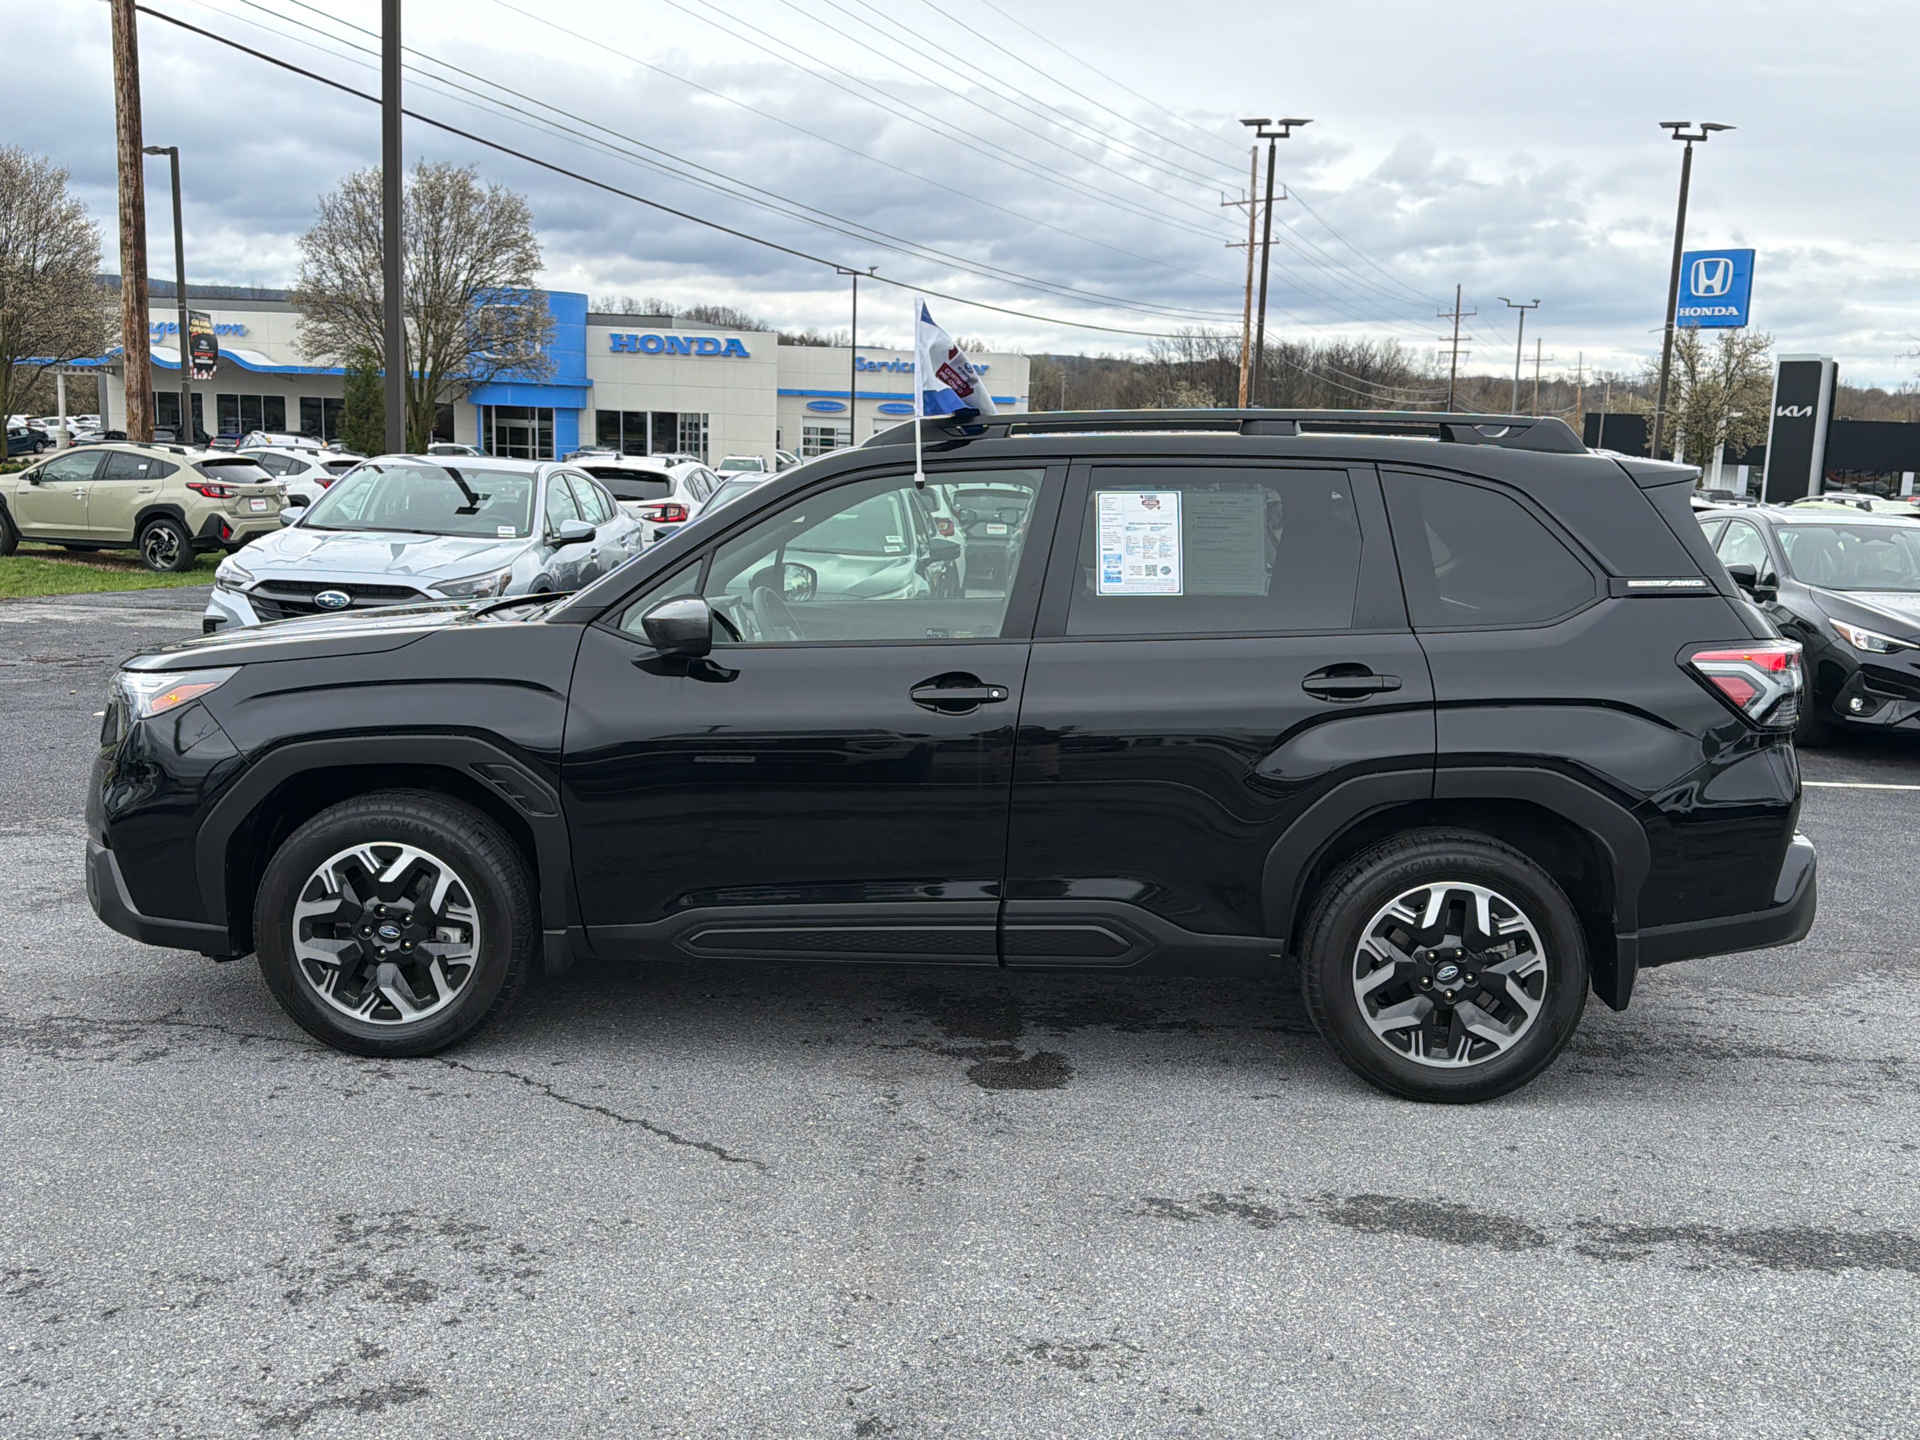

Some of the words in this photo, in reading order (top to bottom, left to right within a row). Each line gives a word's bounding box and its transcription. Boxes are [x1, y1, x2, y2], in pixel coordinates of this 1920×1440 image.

[1679, 306, 1739, 317] HONDA
[609, 333, 750, 357] HONDA
[1776, 405, 1813, 418] KIA
[1382, 857, 1469, 882] YOKOHAMA
